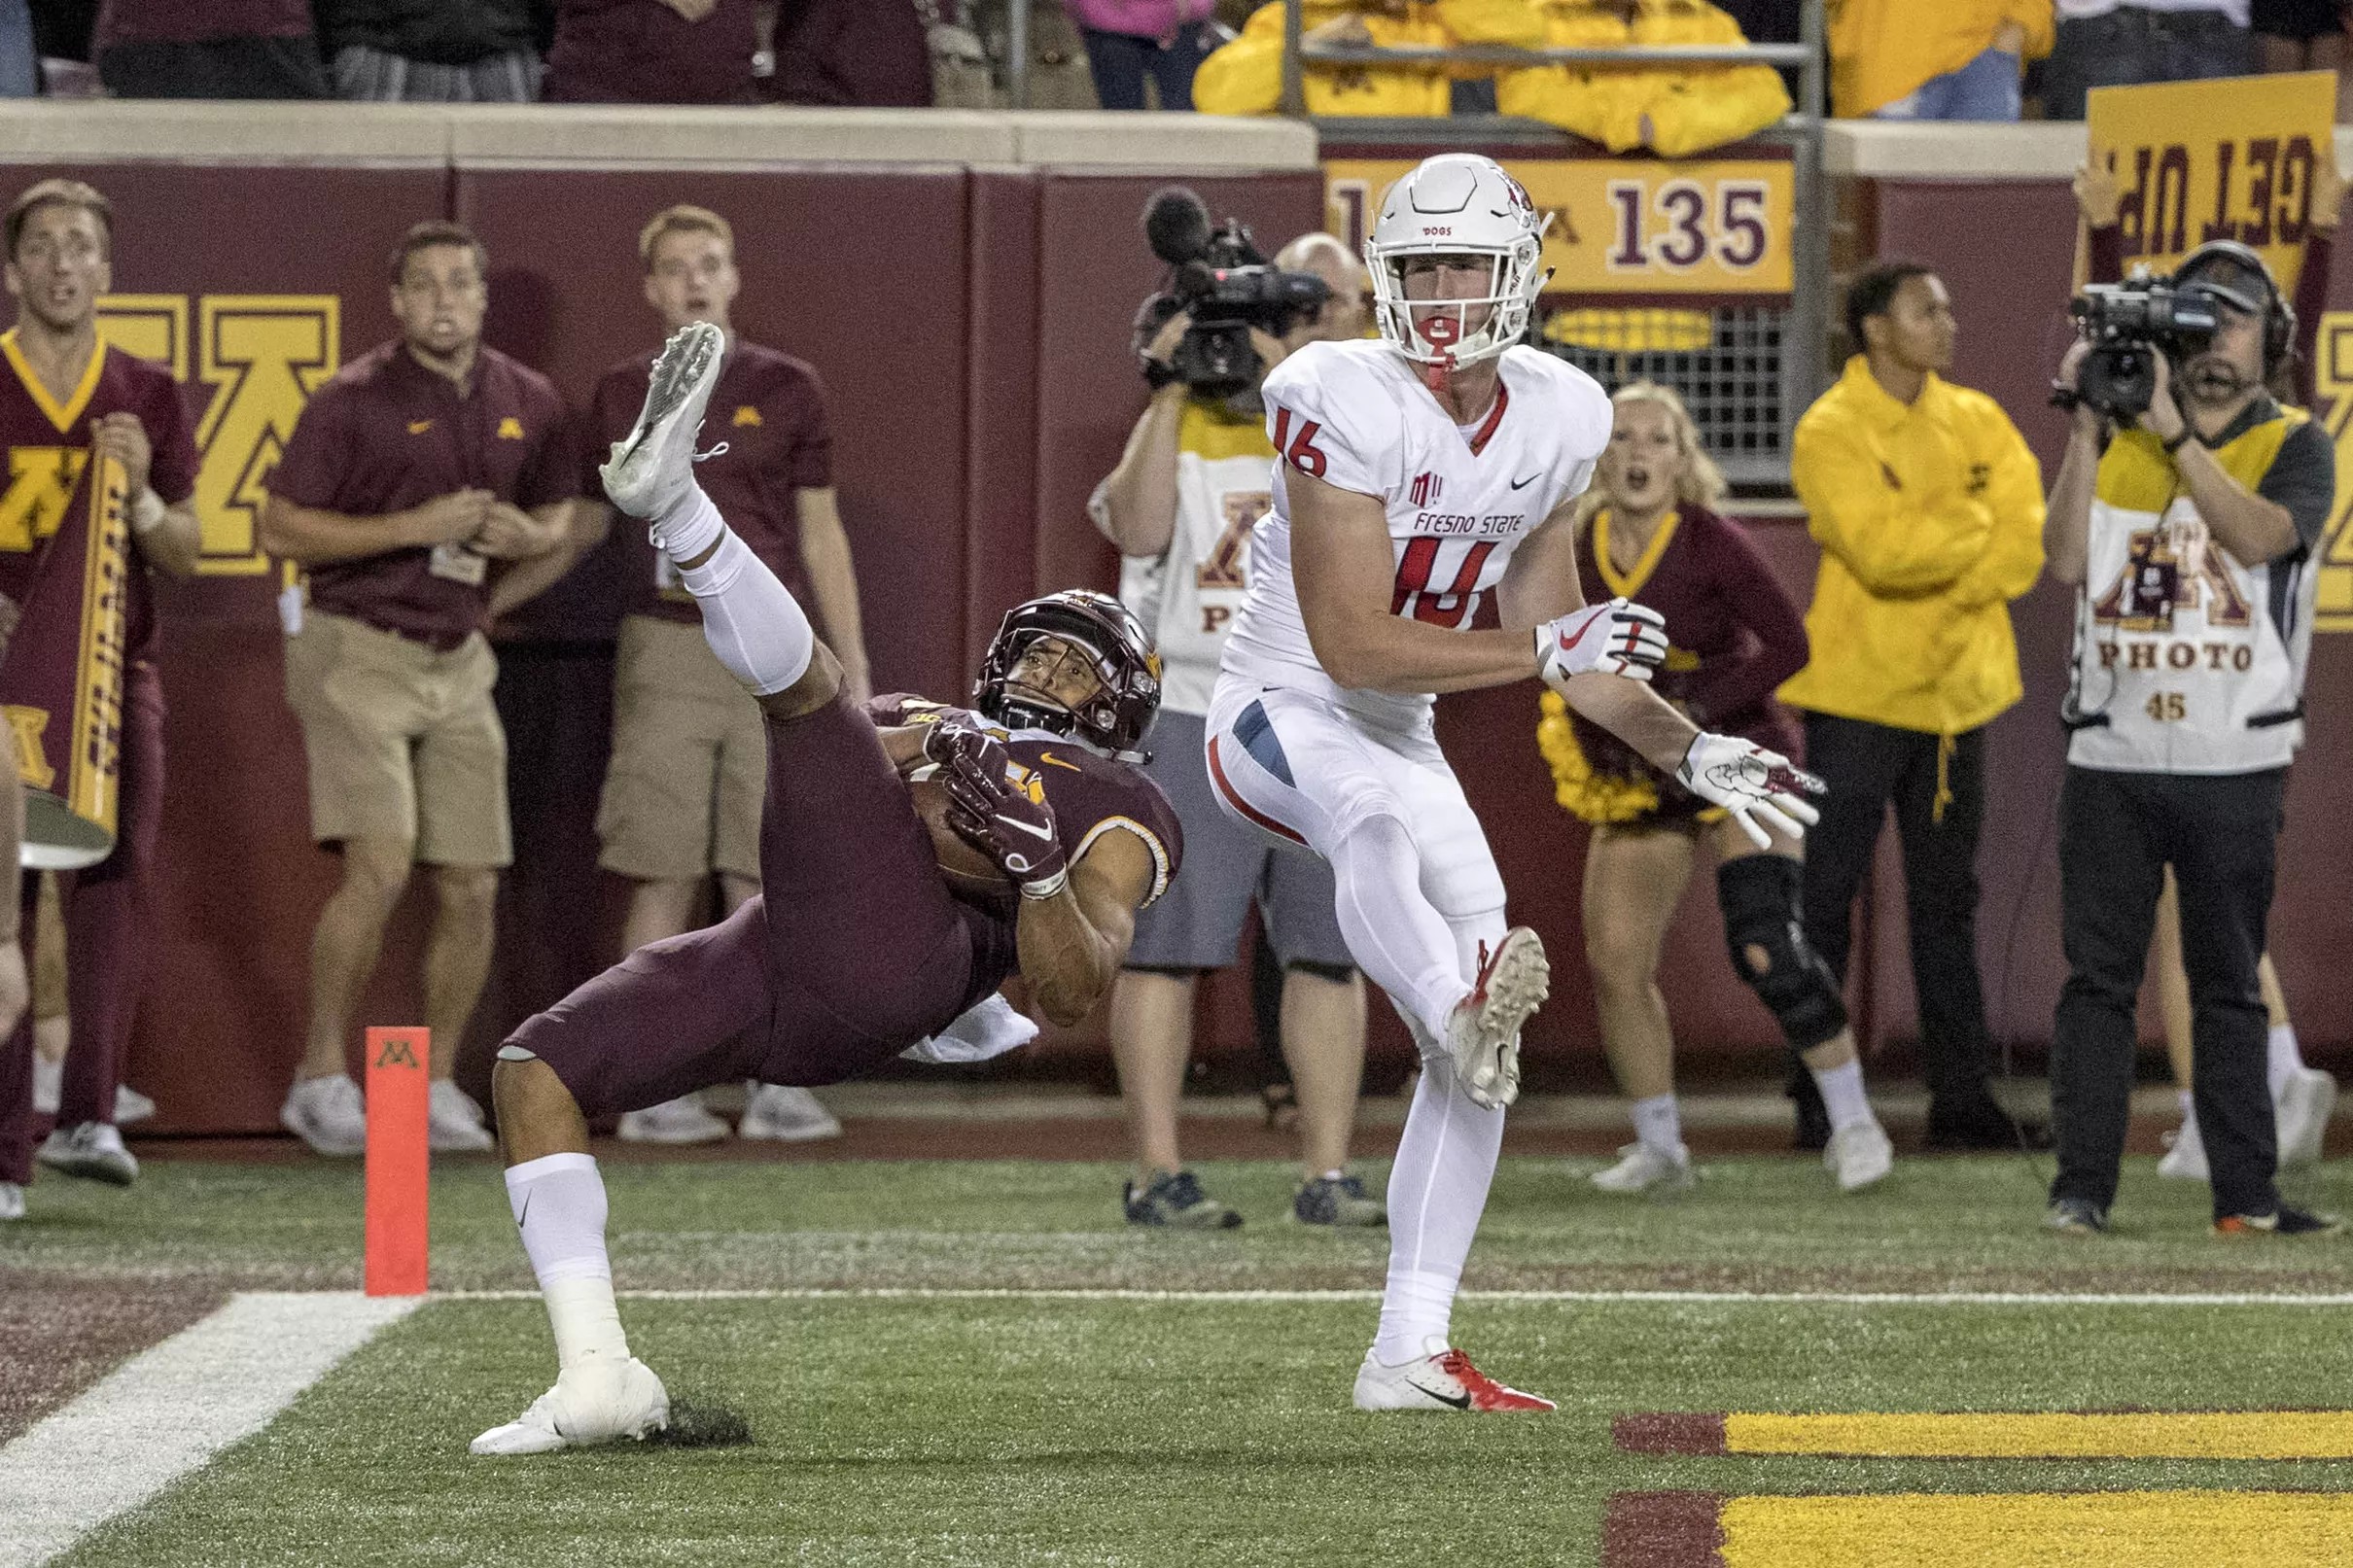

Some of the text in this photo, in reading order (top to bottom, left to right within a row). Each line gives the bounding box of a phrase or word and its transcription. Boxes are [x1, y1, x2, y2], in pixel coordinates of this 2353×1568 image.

[2202, 134, 2315, 247] GET
[1610, 183, 1769, 270] 135
[1273, 406, 1327, 477] 16
[2097, 642, 2252, 672] PHOTO
[2145, 691, 2186, 721] 45
